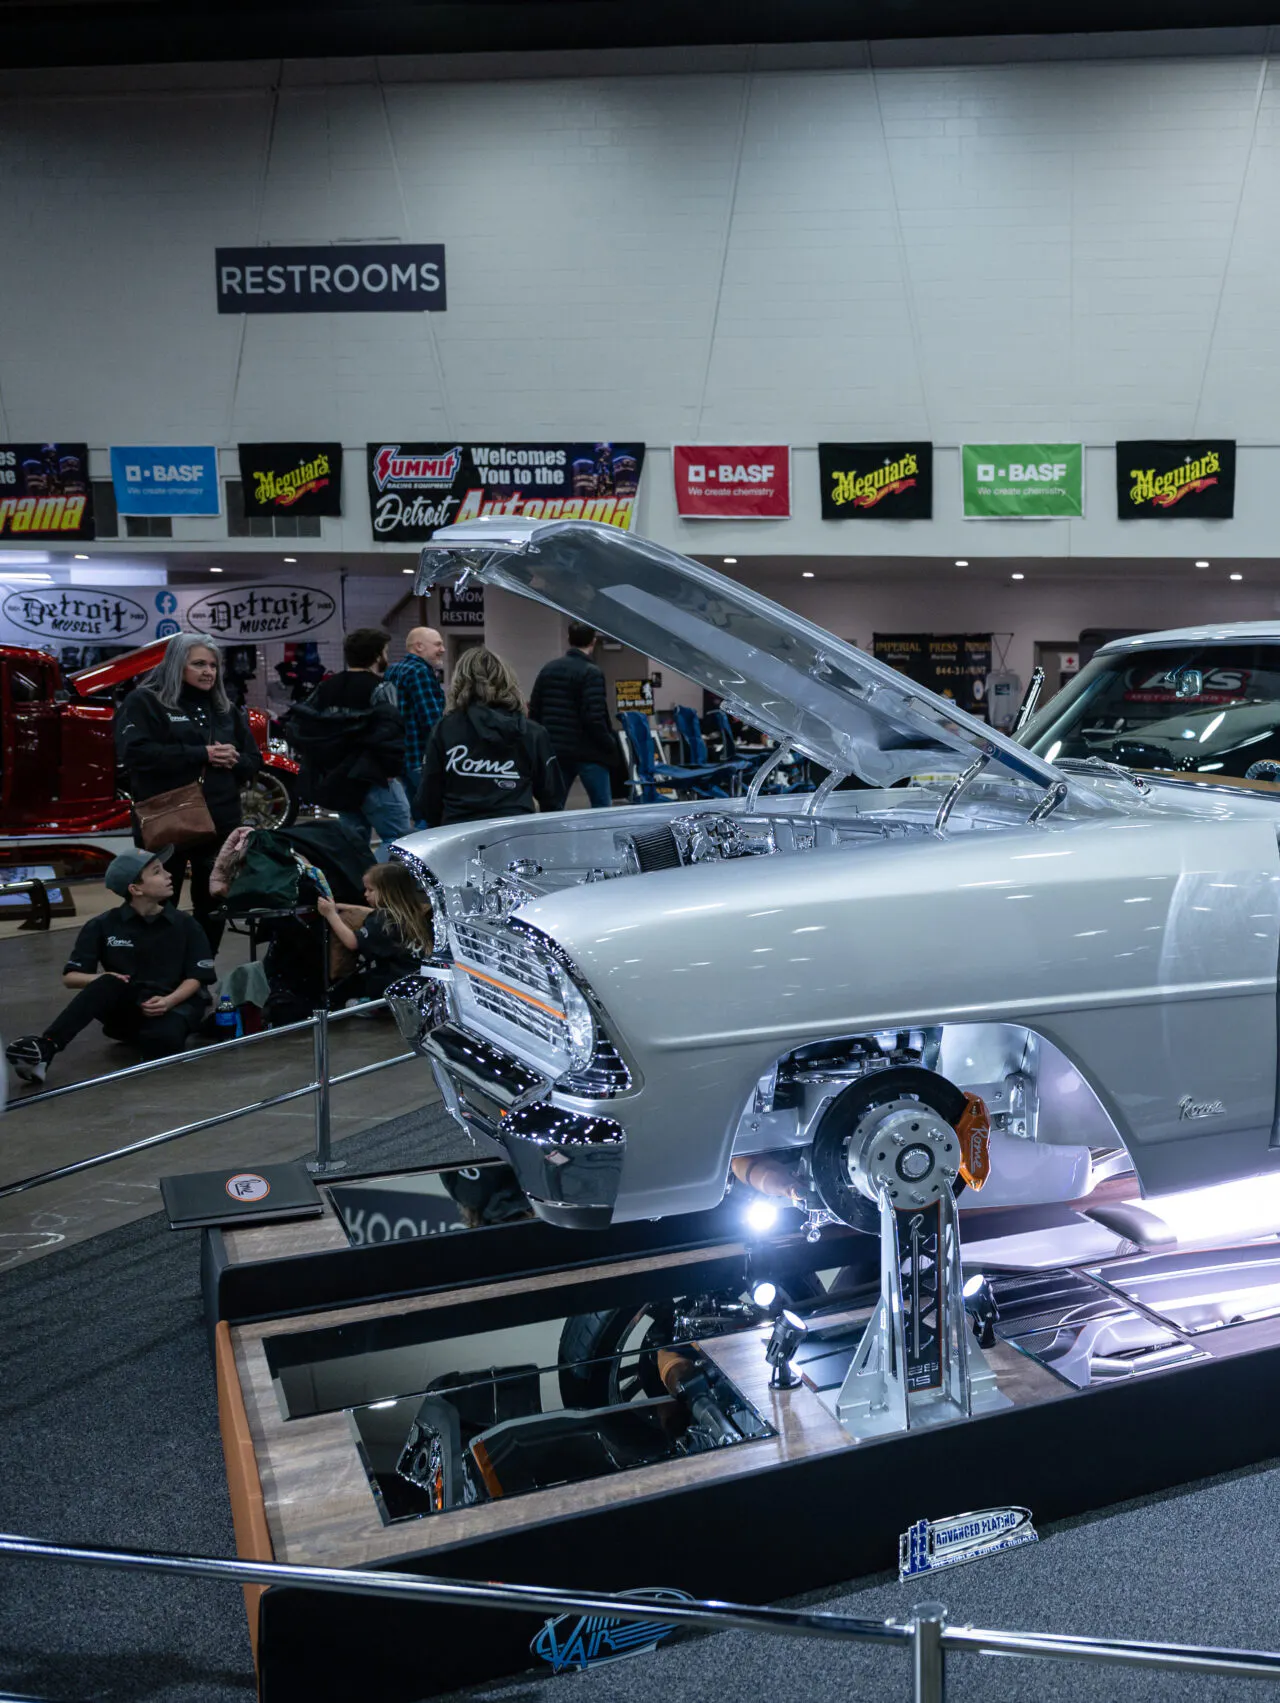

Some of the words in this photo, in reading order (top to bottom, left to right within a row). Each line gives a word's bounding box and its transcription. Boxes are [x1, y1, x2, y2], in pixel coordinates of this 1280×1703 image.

[221, 263, 441, 294] RESTROOMS
[471, 448, 567, 466] Welcomes
[152, 465, 204, 482] BASF
[253, 454, 330, 504] Meguiar's
[478, 467, 511, 485] You
[513, 467, 532, 485] to
[535, 466, 565, 485] the
[718, 464, 775, 483] BASF
[831, 453, 918, 506] Meguiar's
[1009, 463, 1067, 482] BASF
[1129, 451, 1220, 505] Meguiar's
[688, 487, 703, 496] We
[704, 487, 732, 496] create
[733, 487, 775, 498] chemistry
[977, 487, 992, 496] We
[993, 487, 1021, 496] create
[1023, 486, 1067, 497] chemistry
[374, 494, 460, 532] Detroit
[20, 593, 127, 632] Detroit
[207, 591, 314, 632] Detroit
[52, 618, 101, 634] MUSCLE
[239, 616, 290, 633] MUSCLE
[876, 641, 922, 652] IMPERIAL
[929, 642, 958, 652] PRESS
[445, 744, 521, 779] Rome
[106, 935, 135, 948] Rome
[1178, 1095, 1227, 1121] Rome
[970, 1124, 988, 1174] Rome
[936, 1522, 980, 1546] ADVANCED
[982, 1512, 1016, 1534] PLATING
